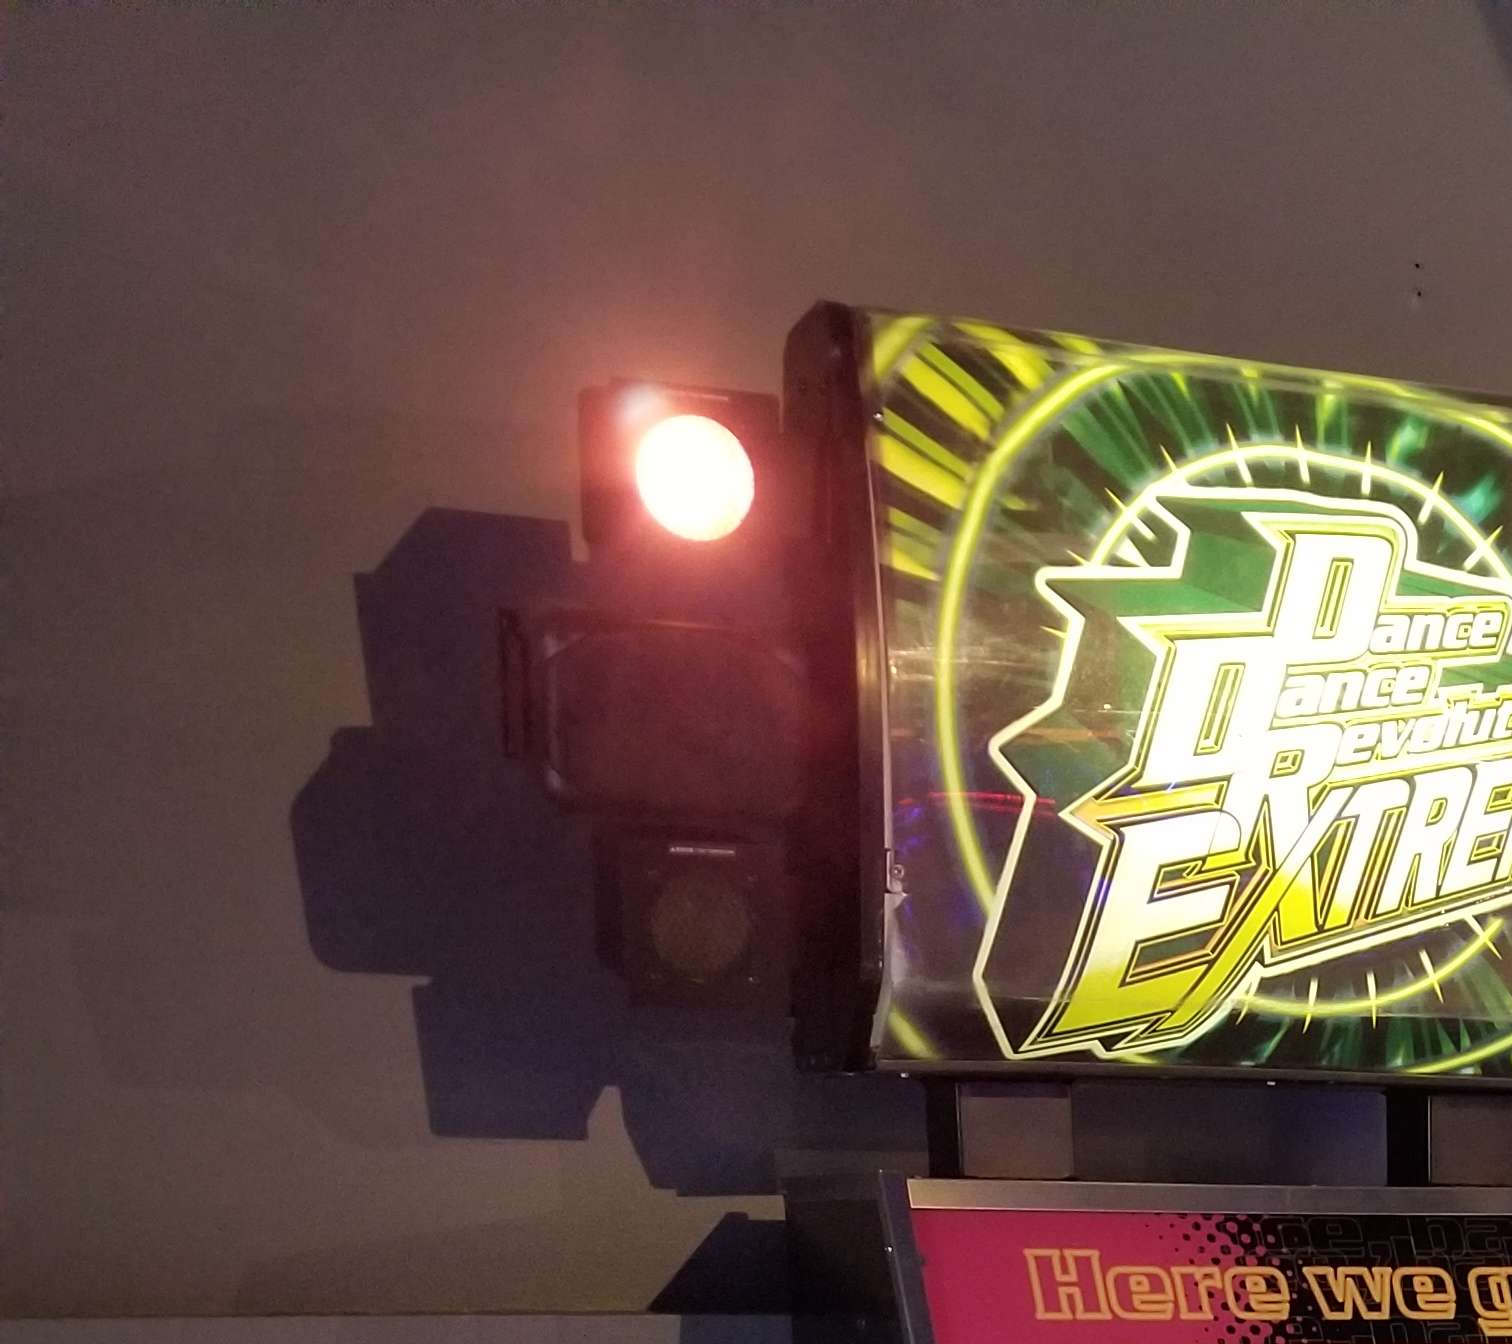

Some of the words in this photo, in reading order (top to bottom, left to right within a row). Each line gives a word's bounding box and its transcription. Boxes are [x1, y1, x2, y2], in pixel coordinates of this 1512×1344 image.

[1268, 533, 1506, 660] Dance
[1142, 635, 1434, 788] Dance
[1024, 1248, 1289, 1322] Here
[1303, 1265, 1457, 1322] we
